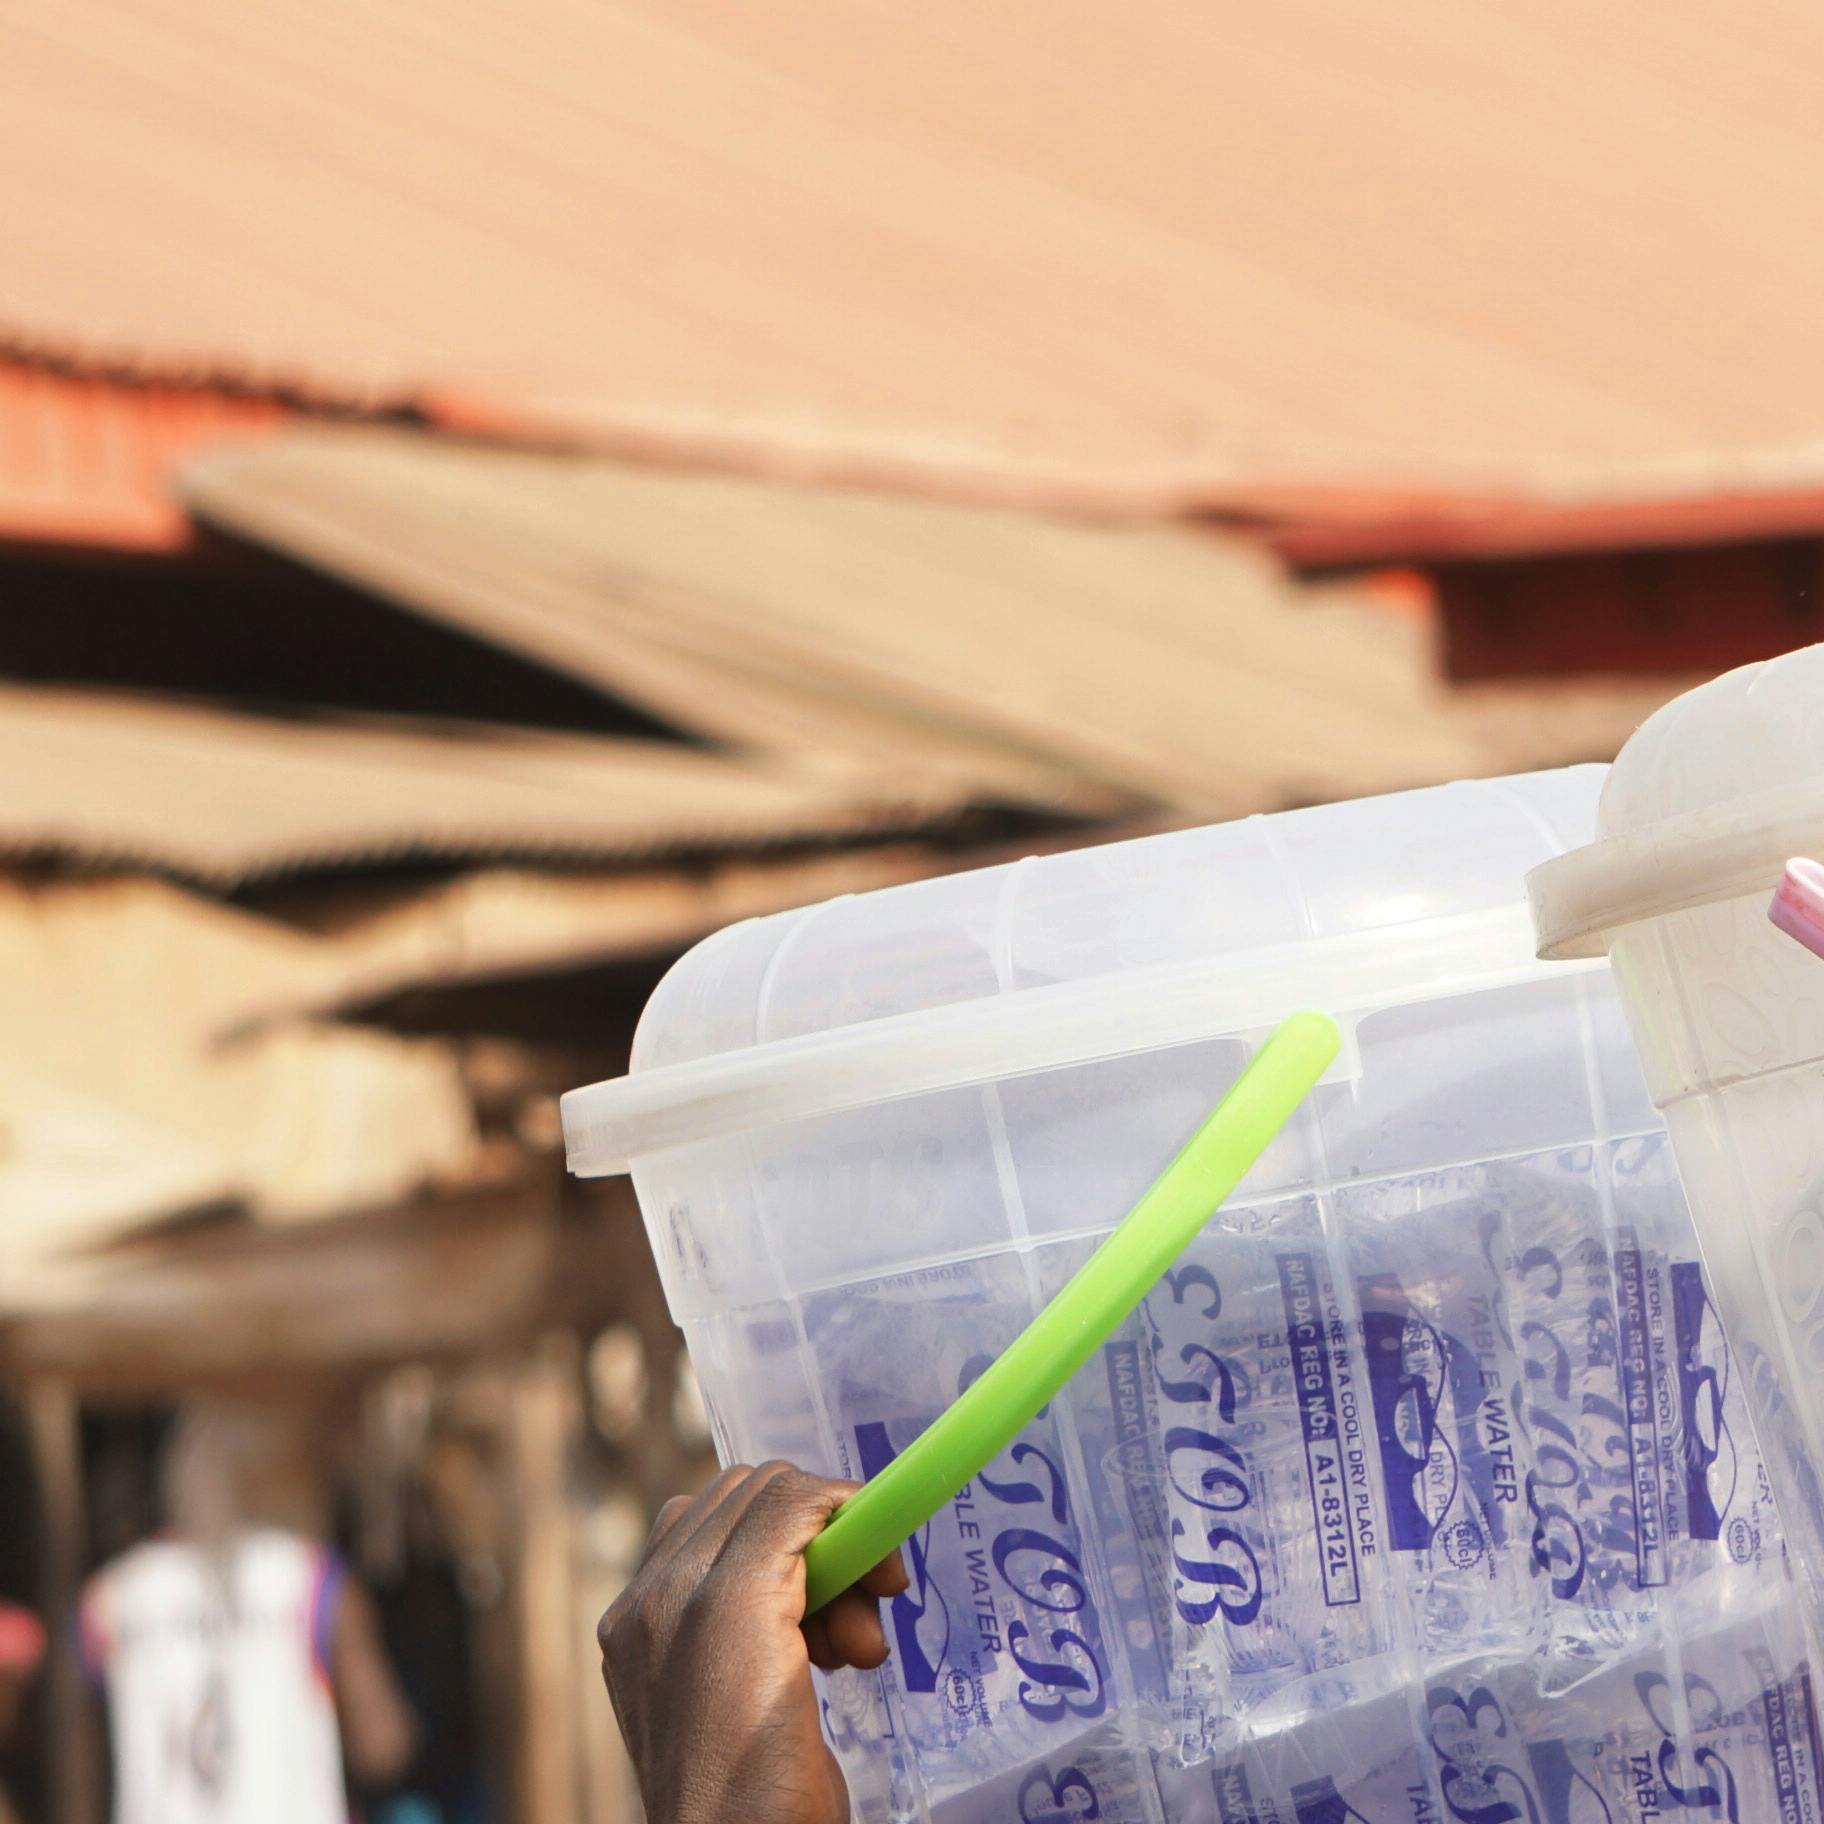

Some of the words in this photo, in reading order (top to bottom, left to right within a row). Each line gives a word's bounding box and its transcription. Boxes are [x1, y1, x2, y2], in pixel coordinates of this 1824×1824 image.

[1285, 1259, 1315, 1341] NAFDAC
[1322, 1283, 1347, 1348] STORE
[1647, 1268, 1664, 1331] STORE
[1333, 1350, 1350, 1369] IN
[1653, 1333, 1666, 1356] IN
[1337, 1374, 1350, 1388] A
[1467, 1297, 1501, 1389] TABLE
[1484, 1398, 1518, 1503] WATER
[1656, 1378, 1672, 1432] COOL
[1340, 1391, 1361, 1447] COOL
[1347, 1450, 1367, 1490] DRY
[1661, 1436, 1676, 1476] DRY
[958, 1354, 1106, 1722] TOB
[1315, 1453, 1348, 1578] A1-8312L
[1354, 1492, 1376, 1557] PLACE
[1665, 1478, 1680, 1542] PLACE
[964, 1549, 1003, 1654] WATER
[1775, 1745, 1791, 1788] REG
[1794, 1749, 1804, 1769] IN
